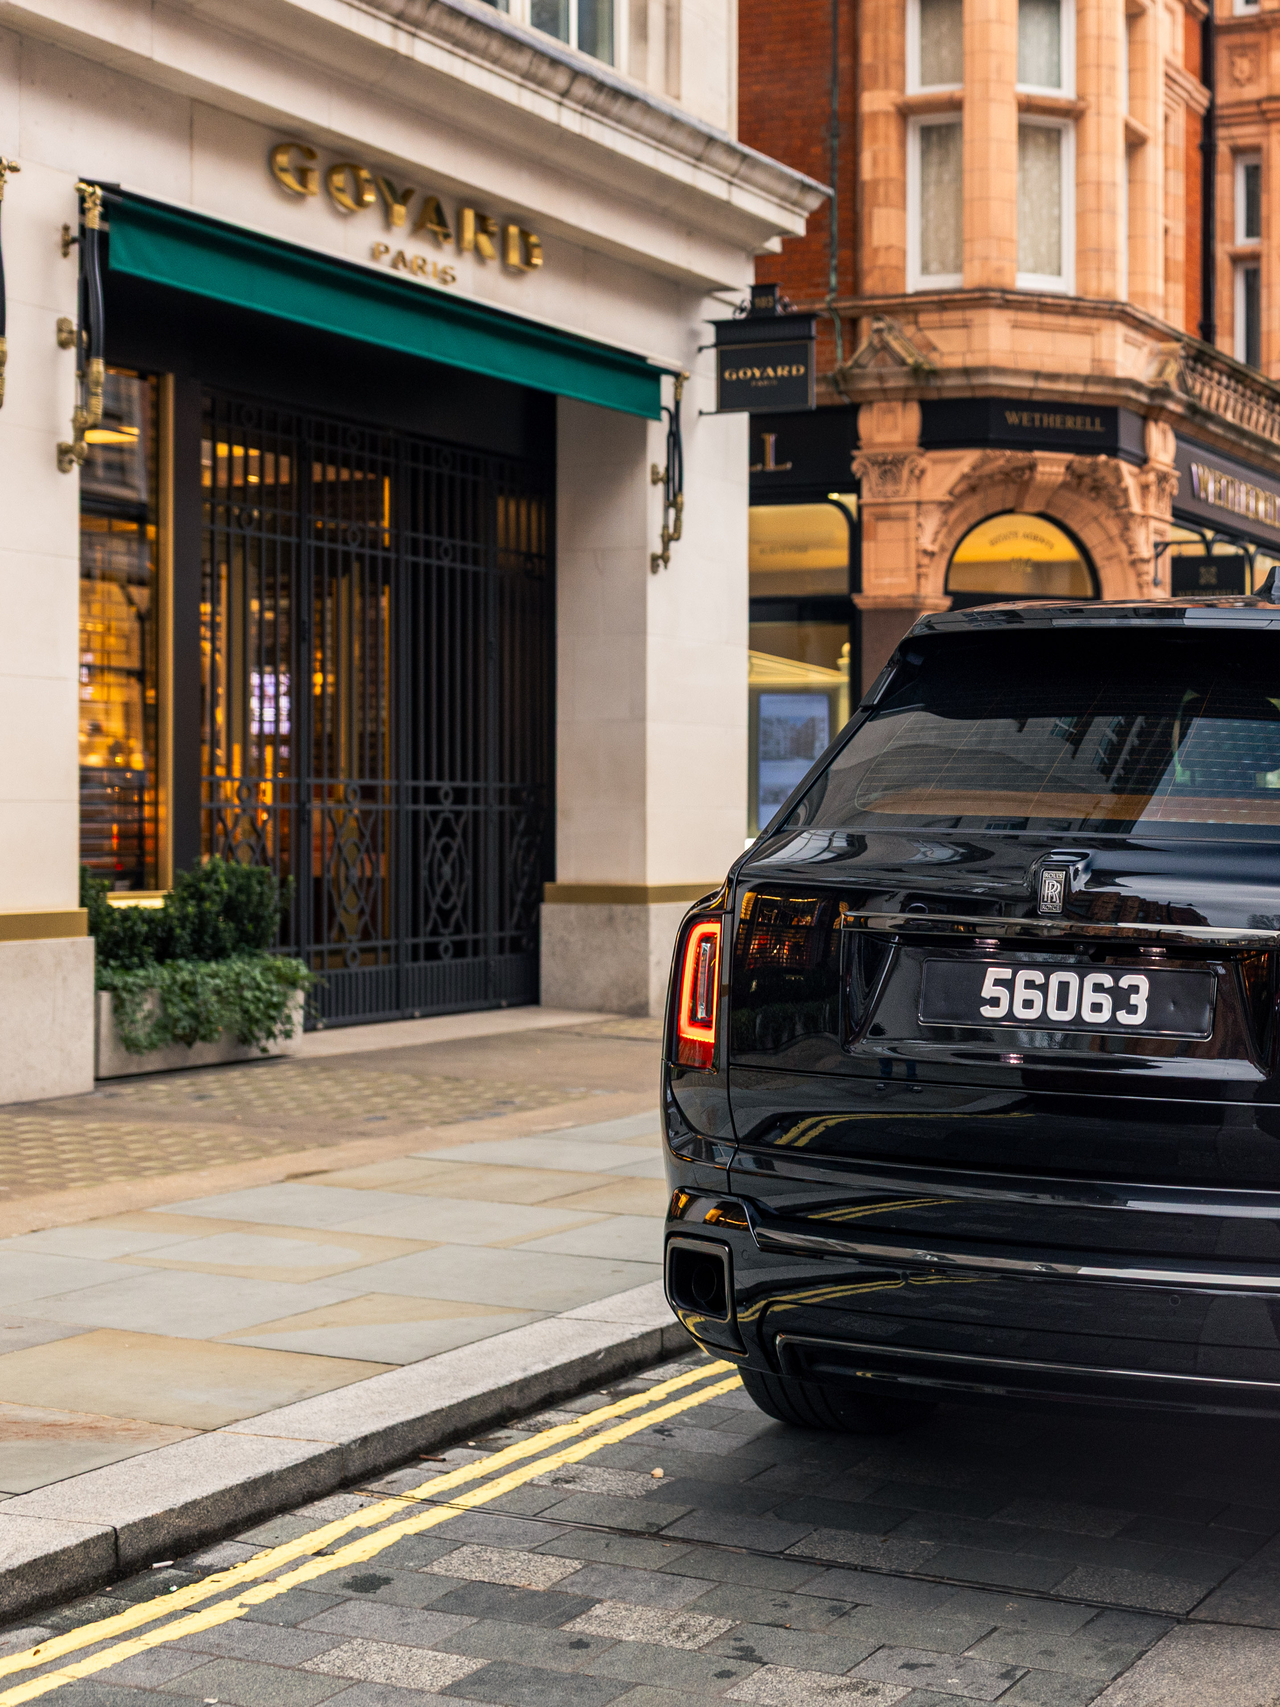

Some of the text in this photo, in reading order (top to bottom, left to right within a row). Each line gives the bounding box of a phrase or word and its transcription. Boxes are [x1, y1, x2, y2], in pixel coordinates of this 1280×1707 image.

[269, 142, 543, 272] GOYARD
[370, 241, 457, 286] PARIS
[723, 363, 806, 381] GOYARD
[1004, 410, 1106, 432] WETHERELL
[980, 967, 1149, 1025] 56063
